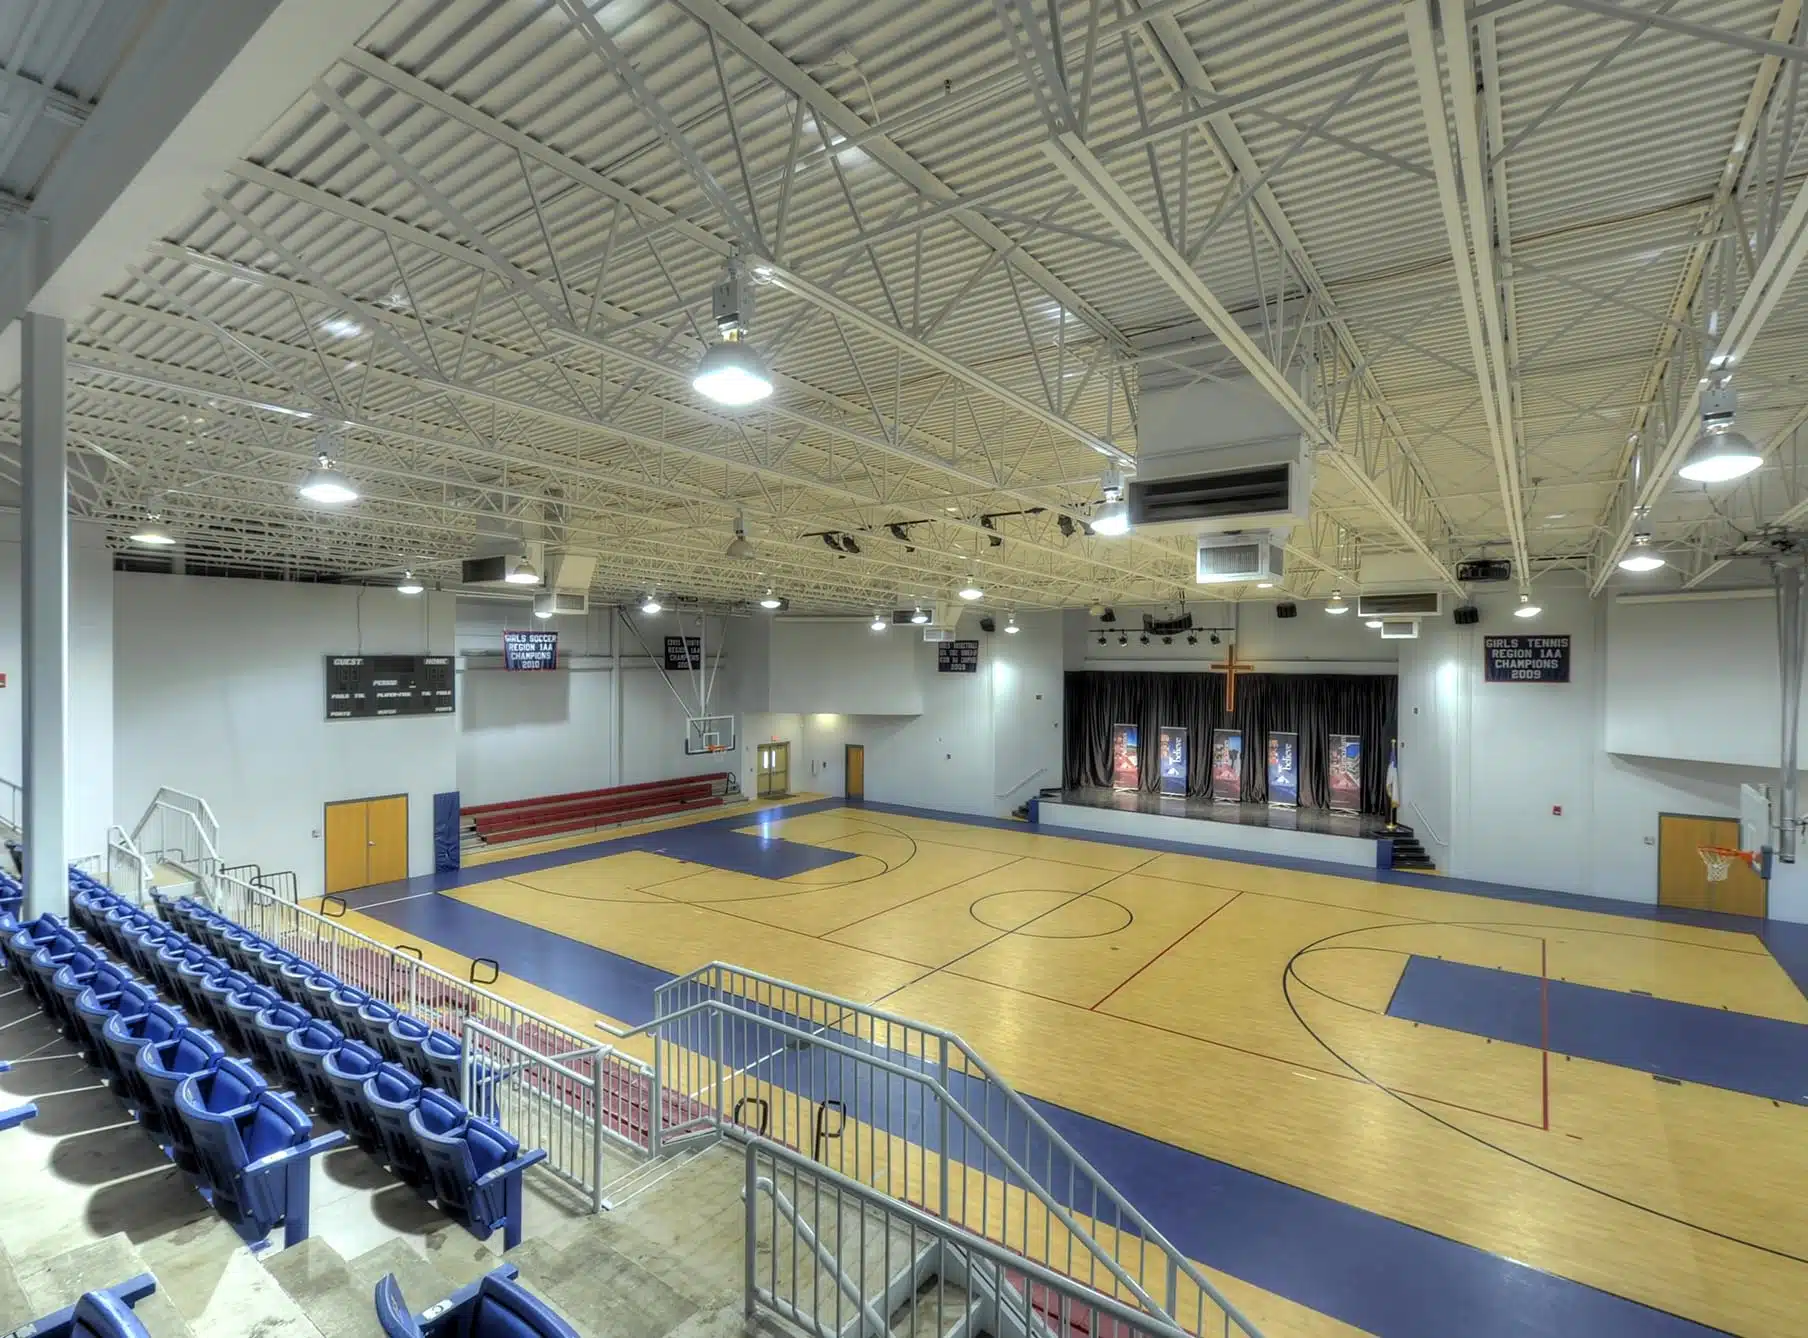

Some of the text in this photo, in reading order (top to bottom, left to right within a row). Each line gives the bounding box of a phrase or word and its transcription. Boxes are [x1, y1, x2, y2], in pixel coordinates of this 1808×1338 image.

[504, 634, 557, 643] GIRLS SOCCER
[1486, 638, 1569, 648] GIRLS TENNIS
[509, 643, 553, 652] REGION 1AA
[511, 651, 552, 661] CHAMPIONS
[1492, 649, 1562, 658] REGION 1AA
[333, 658, 363, 666] GUEST
[522, 660, 541, 669] 2010
[1495, 659, 1559, 669] CHAMPIONS
[1511, 669, 1542, 679] 2009
[1173, 737, 1182, 763] believe
[1281, 744, 1292, 771] believe
